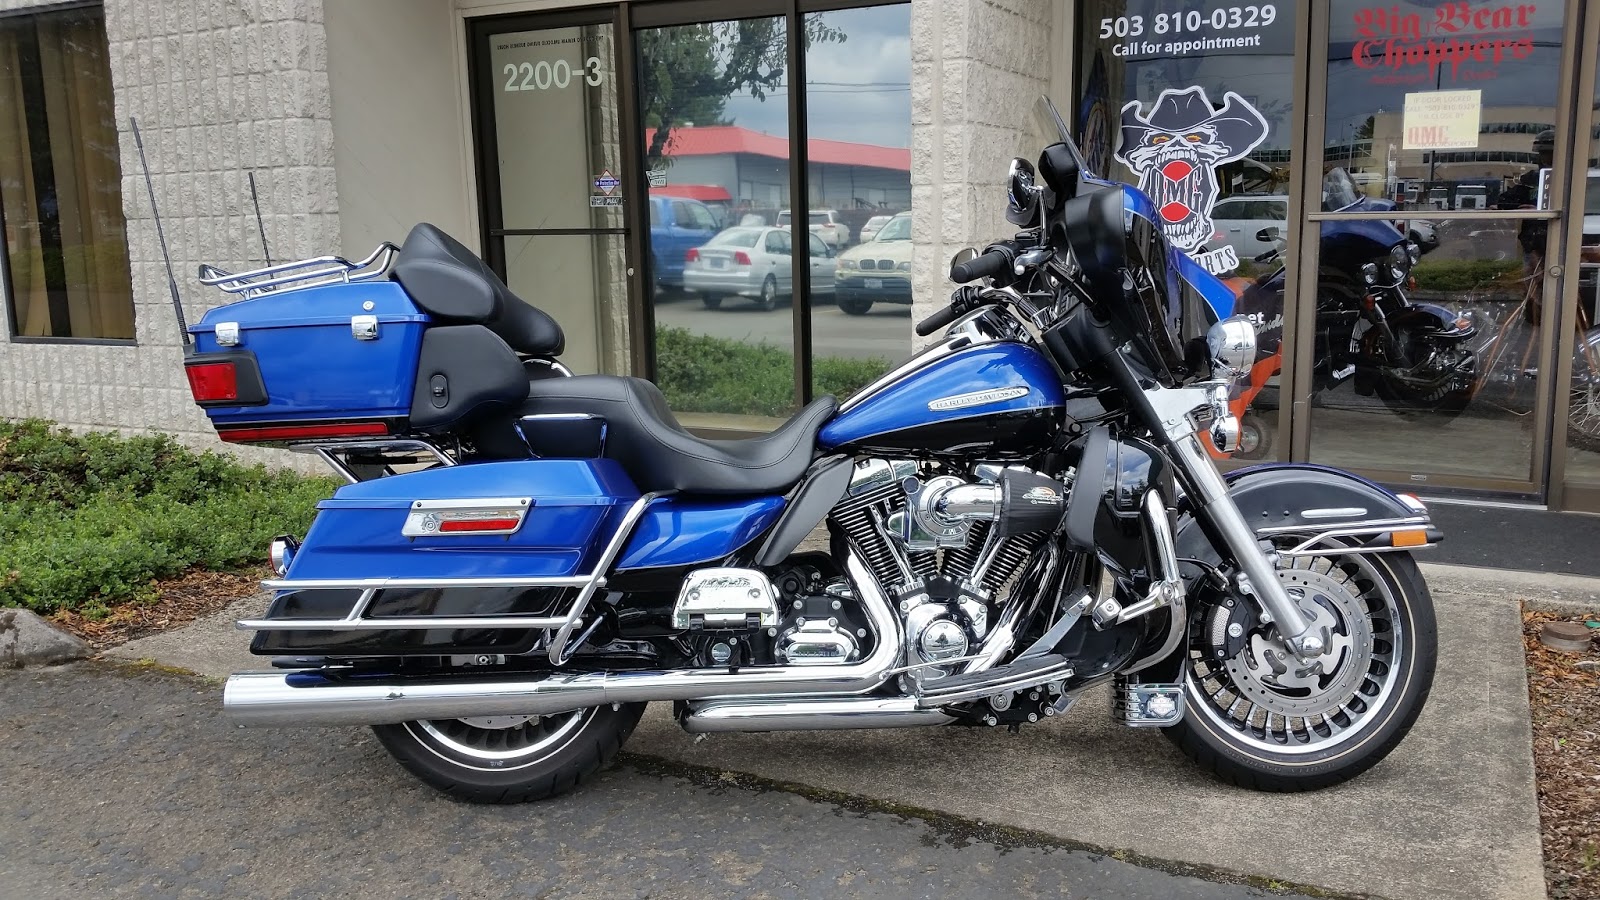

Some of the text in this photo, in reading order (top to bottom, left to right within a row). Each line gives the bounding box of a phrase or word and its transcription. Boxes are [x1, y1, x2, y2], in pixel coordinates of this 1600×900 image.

[1099, 4, 1277, 39] 503 810-0329
[1354, 1, 1536, 43] Big Bear
[1112, 34, 1261, 57] Call for appointment
[1352, 31, 1535, 81] Choppers
[503, 56, 603, 92] 2200-3
[1149, 164, 1203, 214] OMG
[1194, 248, 1237, 273] RTS
